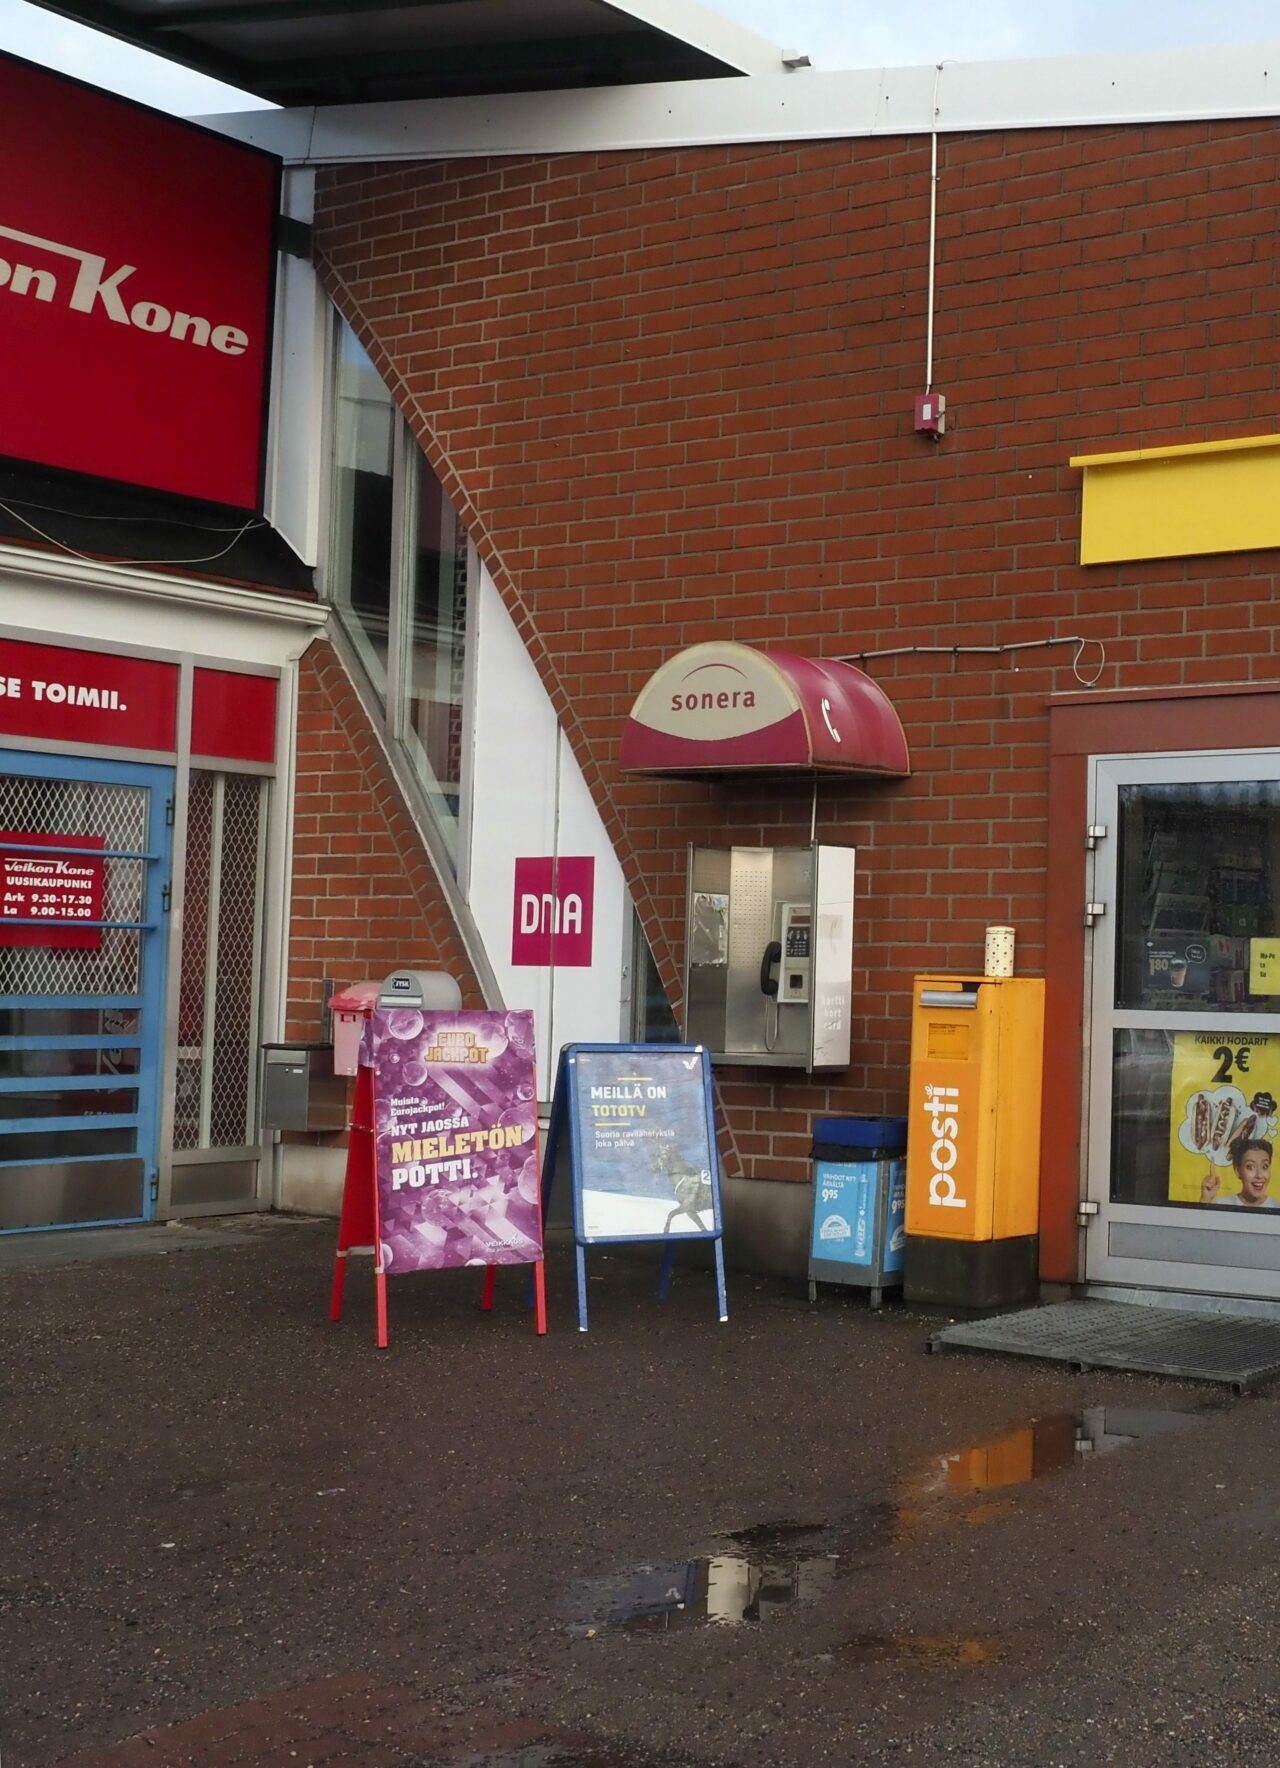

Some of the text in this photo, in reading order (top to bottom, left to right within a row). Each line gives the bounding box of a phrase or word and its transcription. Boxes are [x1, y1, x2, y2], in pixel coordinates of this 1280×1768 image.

[69, 256, 249, 355] Kone
[32, 681, 128, 711] TOIMII.
[671, 688, 756, 712] sonera
[4, 860, 95, 876] Veikon Kone
[6, 876, 92, 889] UUSIKAUPUNKI
[4, 892, 92, 904] Ark 9.30-17.30
[3, 905, 92, 917] La 9.00-15.00
[520, 893, 582, 935] DNA
[437, 1032, 476, 1048] EURO
[1195, 1035, 1269, 1046] KAIKKI HODARIT
[424, 1047, 489, 1063] JACKPOT
[1211, 1046, 1250, 1083] 2€
[590, 1083, 667, 1099] MEILLÄ ON
[390, 1096, 420, 1107] Muista
[390, 1102, 446, 1117] Eurojackpot!
[591, 1105, 647, 1117] TOTOTV
[391, 1116, 470, 1136] NYT JAOSSA
[391, 1124, 523, 1164] MIELETÖN
[594, 1140, 612, 1150] joka
[924, 1084, 967, 1208] posti
[392, 1158, 479, 1191] POTTI.
